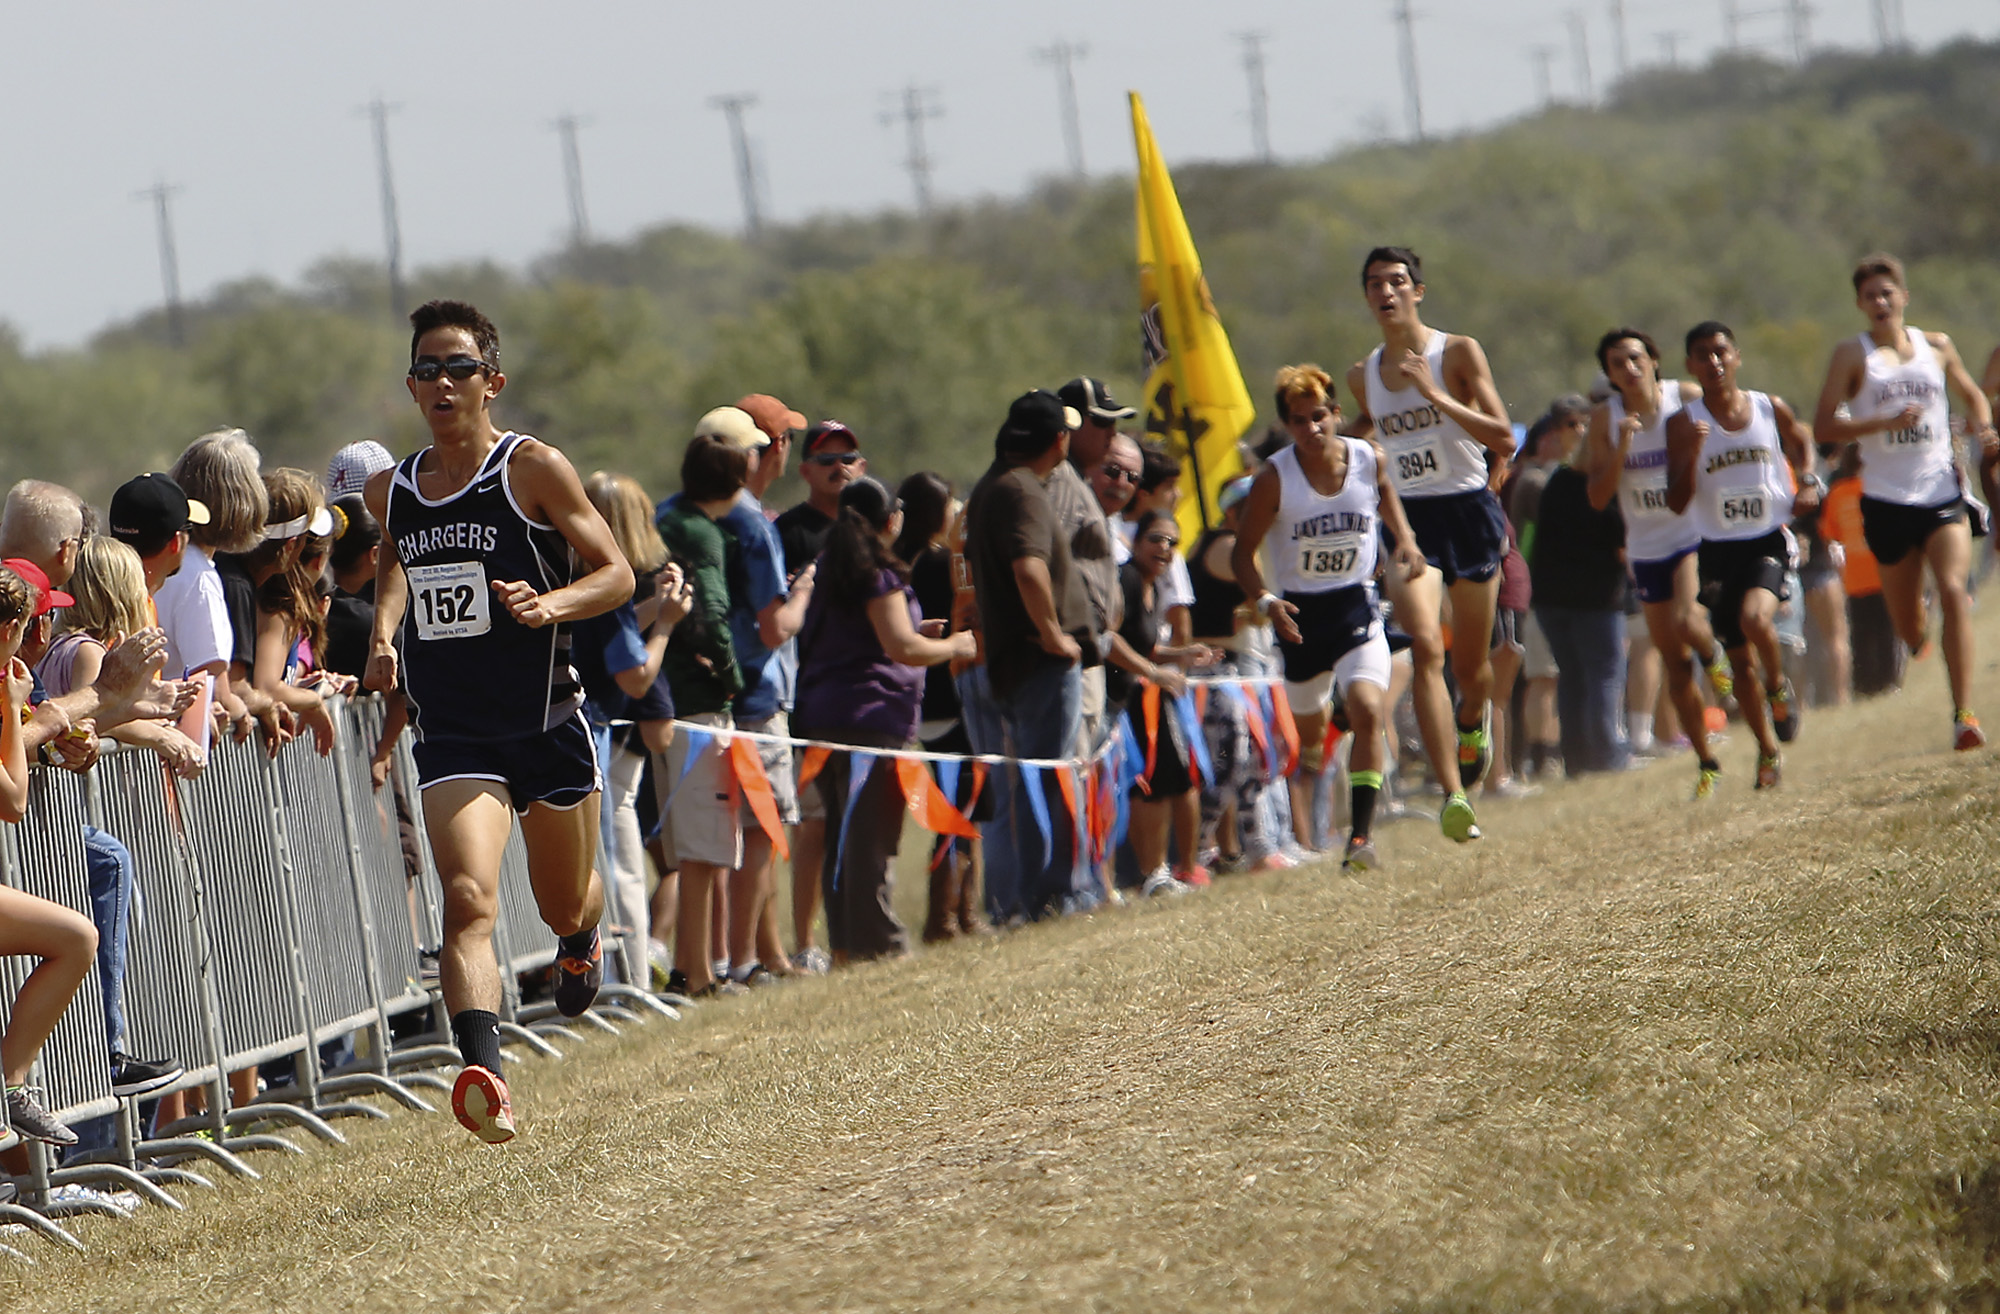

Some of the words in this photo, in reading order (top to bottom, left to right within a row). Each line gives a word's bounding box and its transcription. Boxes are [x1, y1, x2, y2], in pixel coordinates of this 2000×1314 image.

[1724, 498, 1763, 518] 540
[398, 522, 498, 564] CHARGERS
[1302, 547, 1358, 573] 1387
[420, 584, 477, 625] 152
